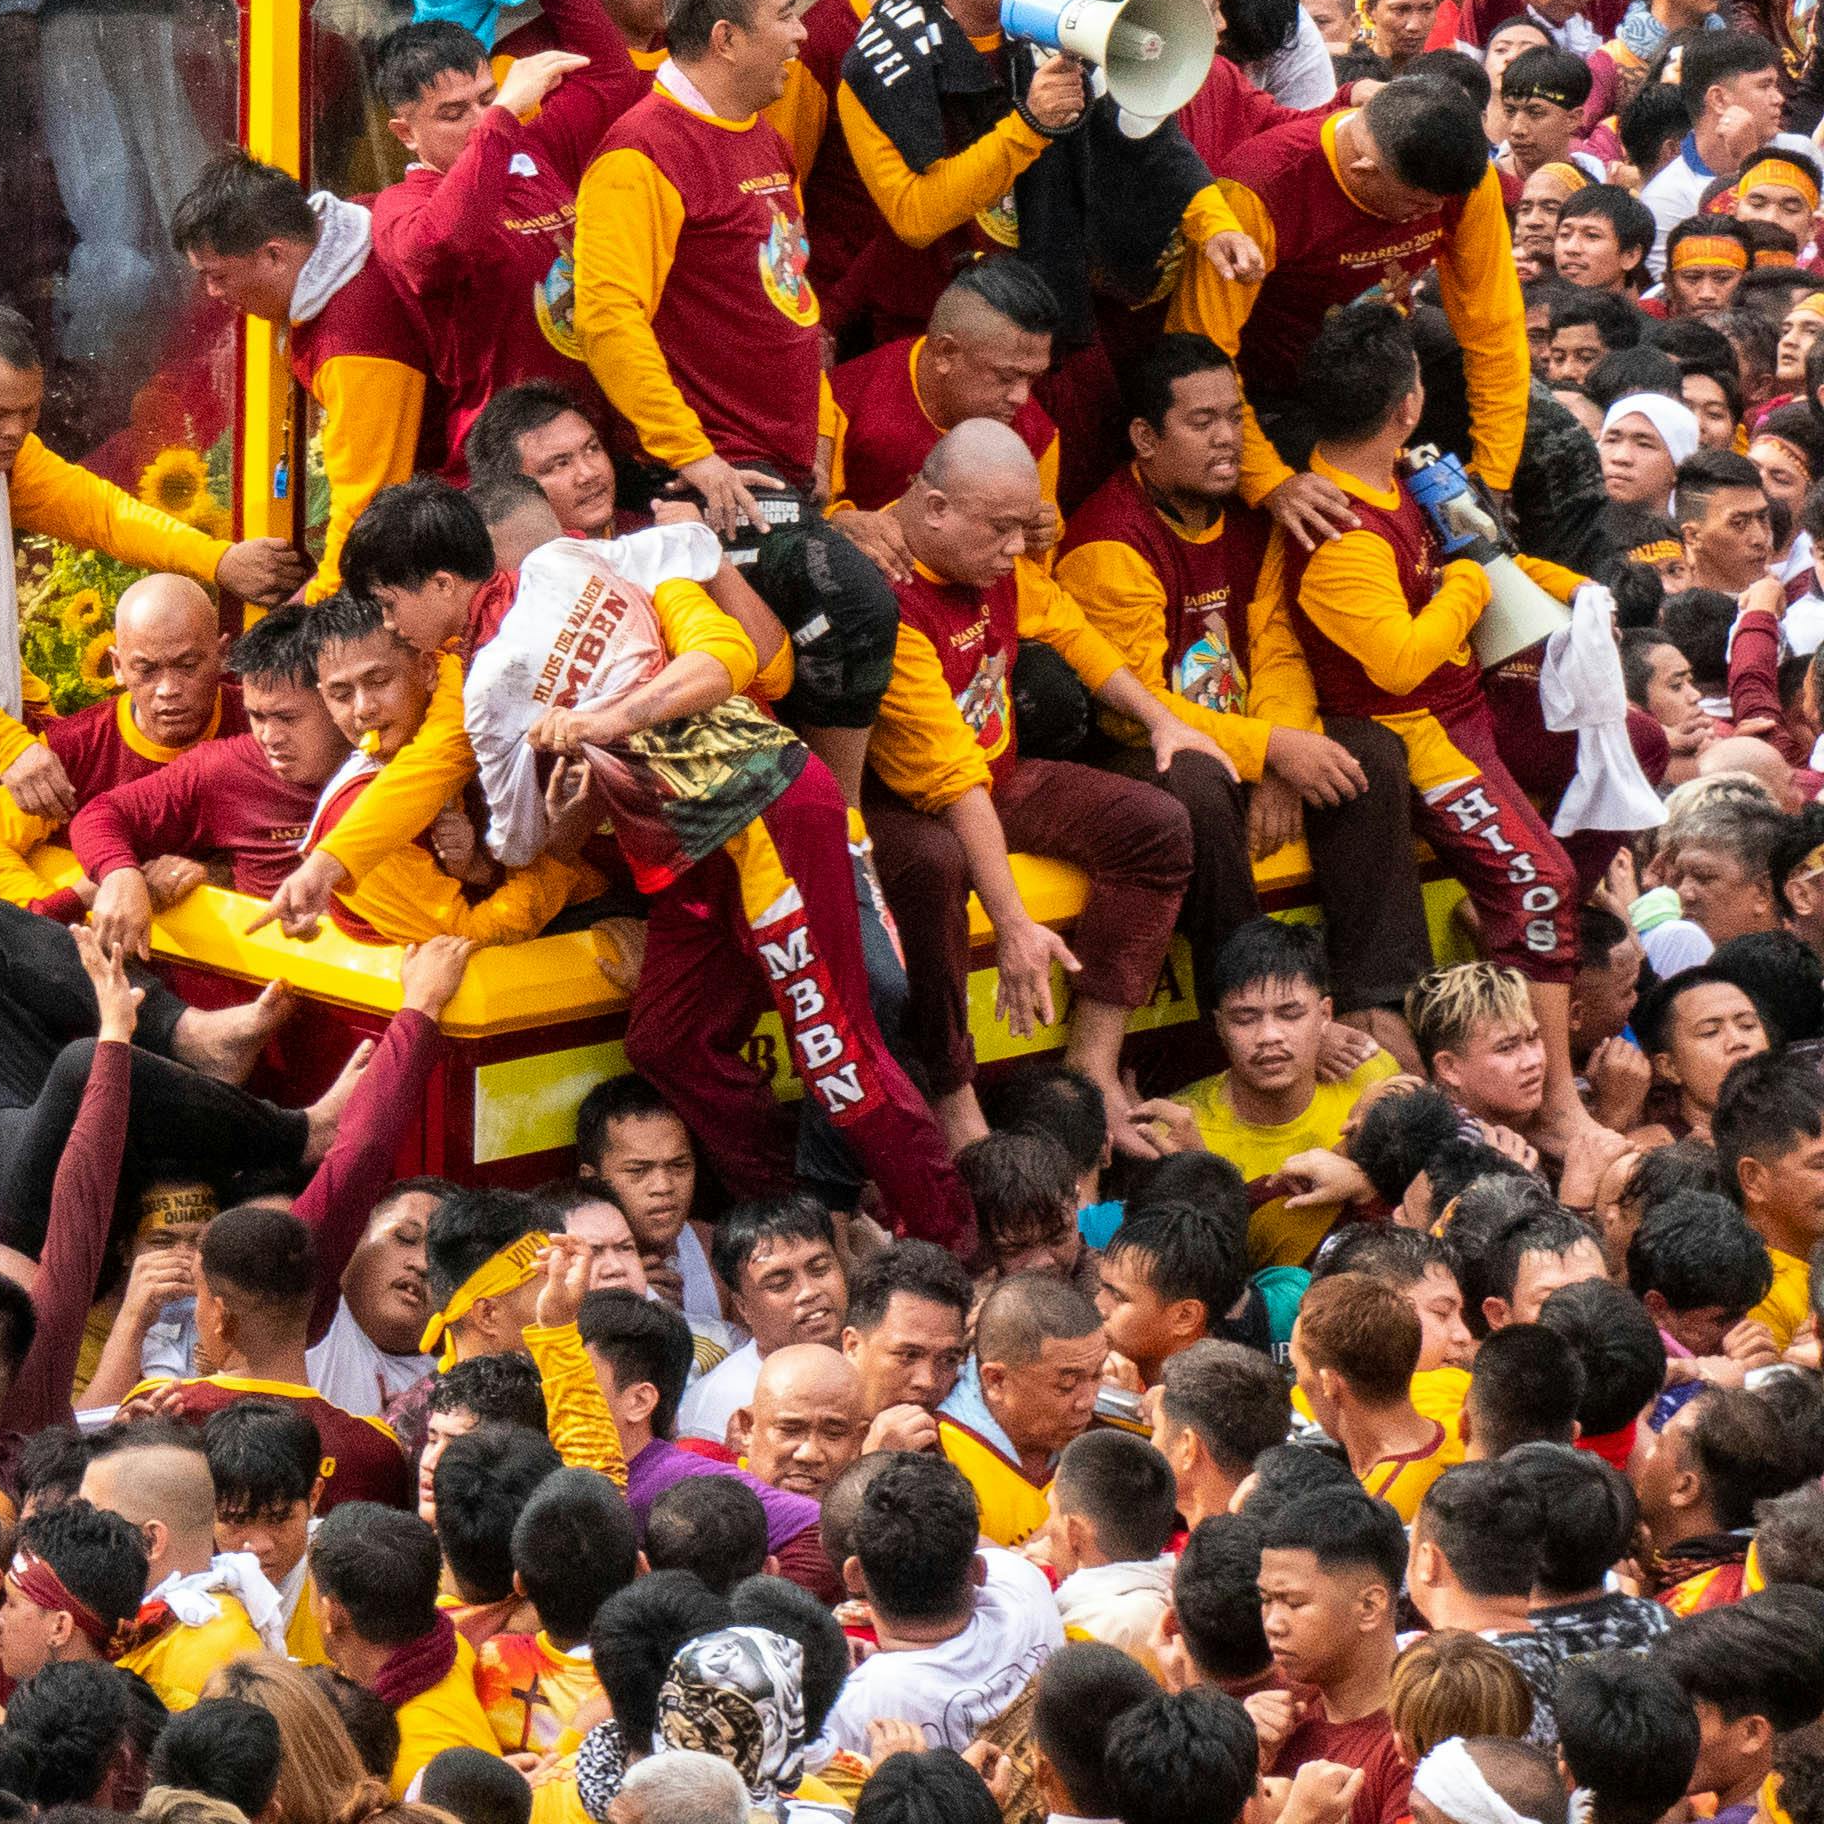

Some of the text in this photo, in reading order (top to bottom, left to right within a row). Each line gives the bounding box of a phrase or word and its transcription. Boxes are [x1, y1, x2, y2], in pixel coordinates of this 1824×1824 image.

[553, 589, 631, 708] MBBN
[566, 573, 603, 629] NAZARENO
[1447, 788, 1559, 954] HIJOS
[759, 927, 865, 1114] MBBN
